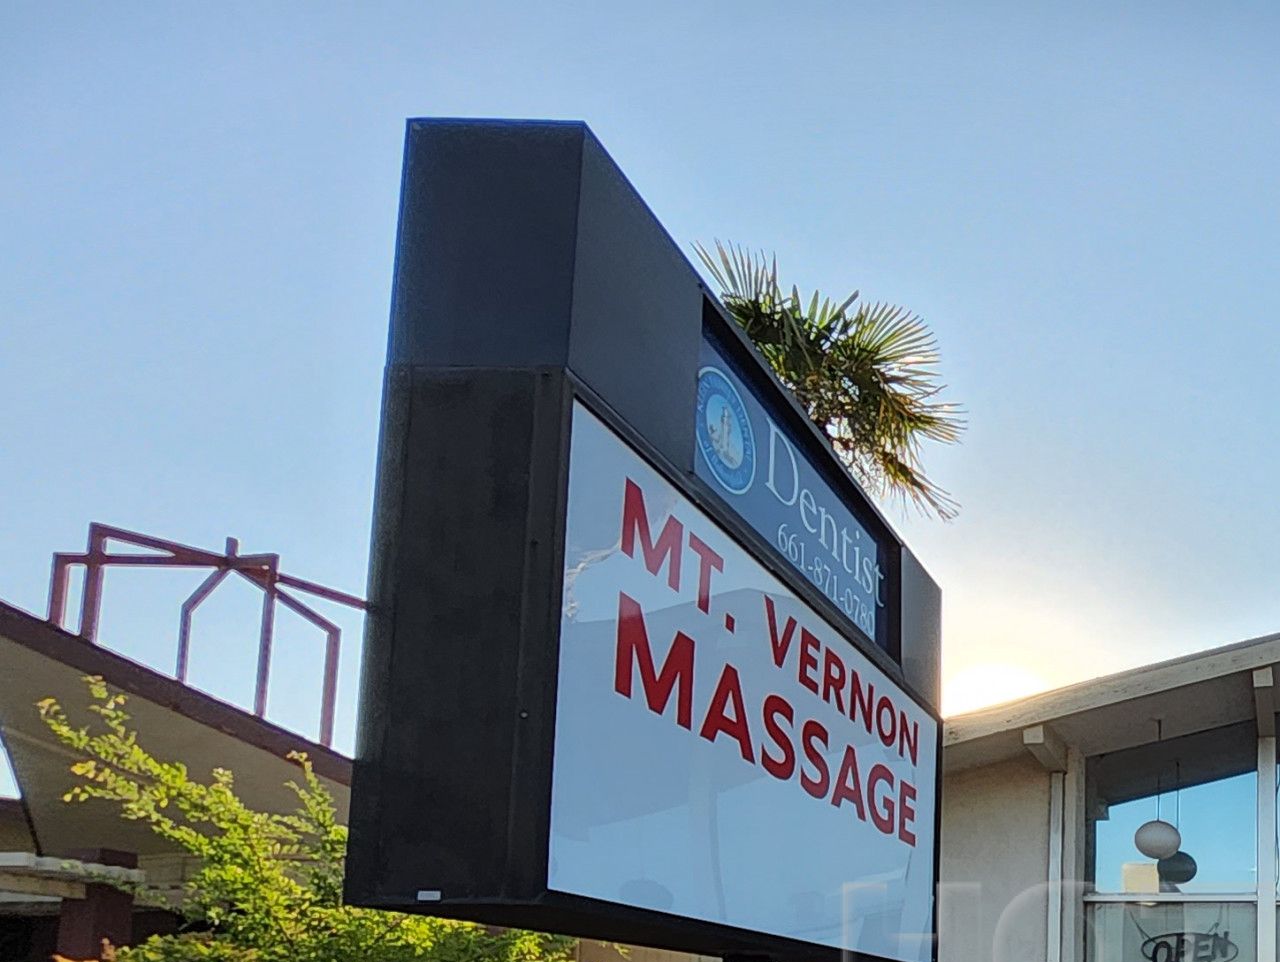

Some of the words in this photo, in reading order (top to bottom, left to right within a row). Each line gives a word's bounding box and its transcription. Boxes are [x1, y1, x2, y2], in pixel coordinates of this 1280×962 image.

[620, 475, 736, 636] MT.
[764, 593, 919, 768] VERNON
[765, 416, 885, 608] Dentist
[776, 522, 876, 638] 661-871-0780
[614, 590, 918, 848] MASSAGE
